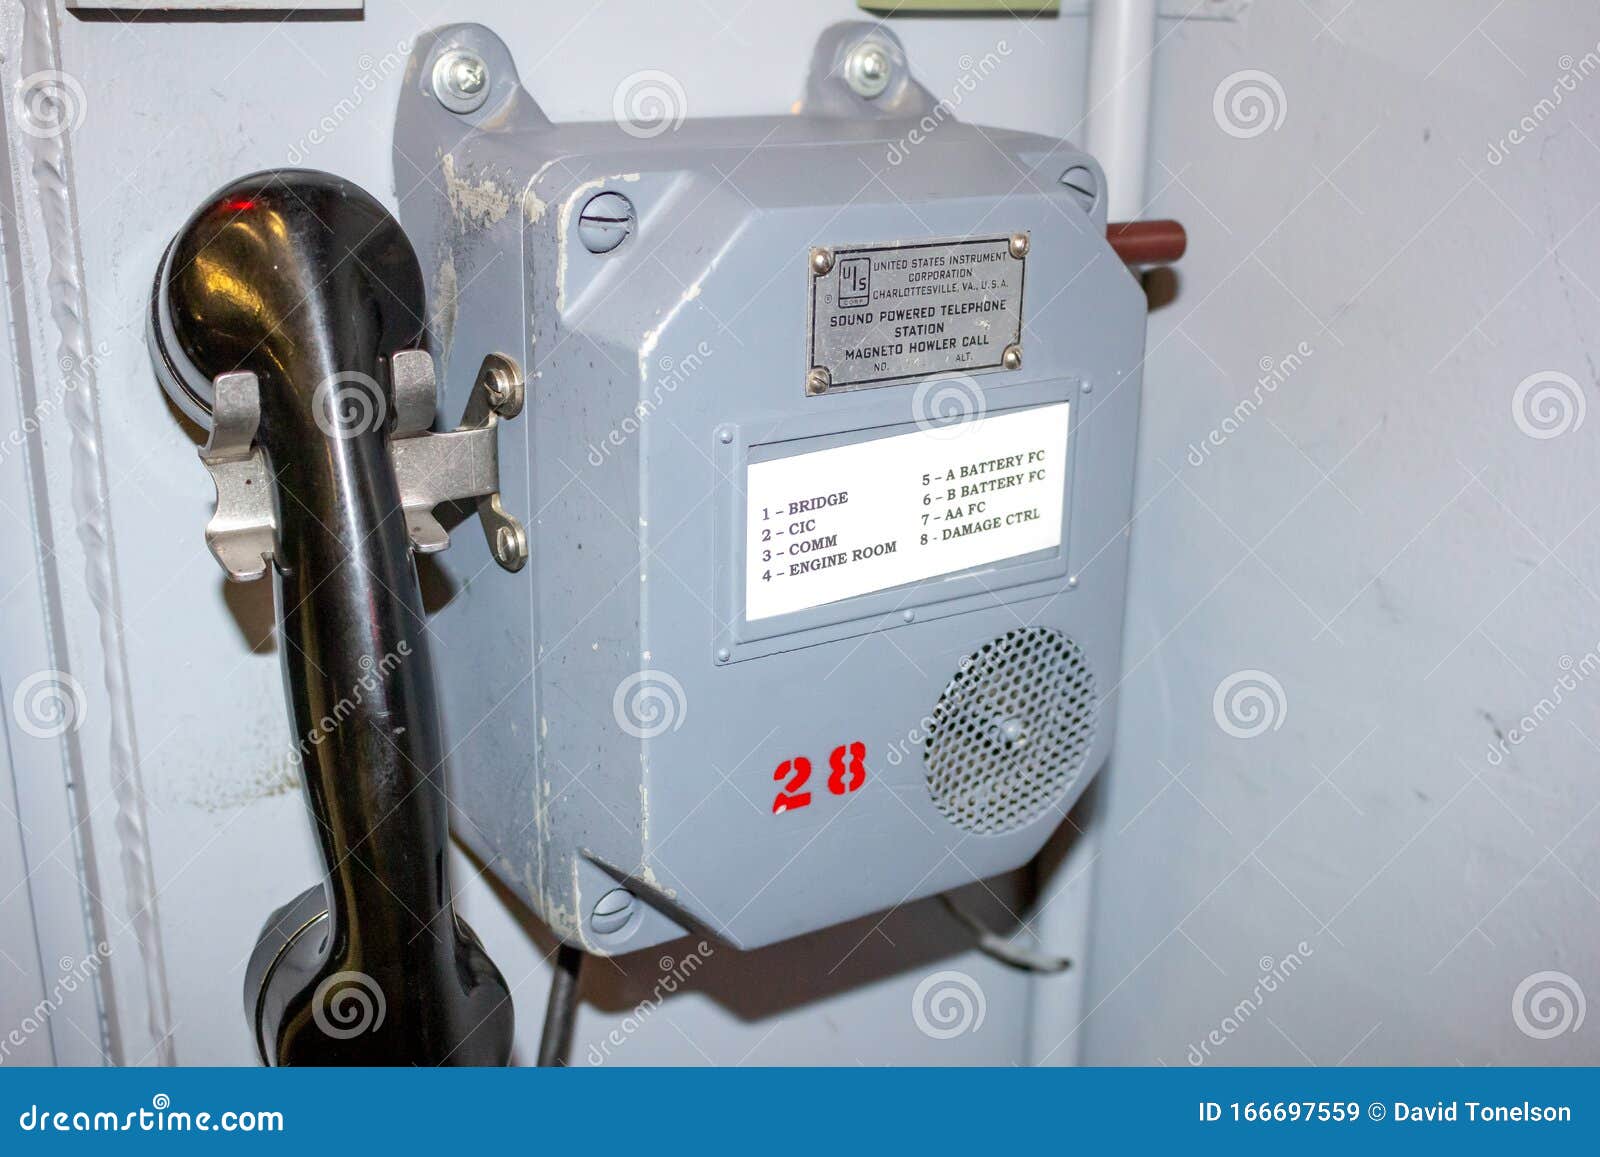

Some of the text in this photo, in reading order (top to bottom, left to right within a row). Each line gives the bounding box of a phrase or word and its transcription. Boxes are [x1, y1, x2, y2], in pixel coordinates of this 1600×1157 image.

[873, 252, 1007, 272] UNITED STATES INSTRUMENT
[908, 268, 973, 282] CORPORATION
[830, 299, 1006, 327] SOUND POWERED TELEPHONE
[895, 322, 945, 337] STATION
[845, 335, 989, 360] MAGNETO HOWLER CALL
[922, 474, 930, 486] 5
[946, 469, 956, 481] A
[960, 454, 1024, 478] BATTERY
[1028, 450, 1045, 463] FC
[923, 494, 932, 506] 6
[947, 489, 956, 501] B
[961, 474, 1024, 498] BATTERY
[1029, 469, 1046, 483] FC
[762, 508, 770, 520] 1
[788, 491, 849, 515] BRIDGE
[921, 514, 930, 526] 7
[945, 507, 963, 521] AA
[968, 501, 986, 515] FC
[762, 529, 771, 542] 2
[789, 519, 816, 535] CIC
[920, 533, 928, 545] 8
[942, 517, 1002, 541] DAMAGE
[1006, 508, 1040, 525] CTRL
[762, 549, 771, 562] 3
[789, 534, 838, 556] COMM
[762, 569, 772, 582] 4
[789, 552, 848, 576] ENGINE
[852, 541, 897, 562] ROOM
[772, 741, 866, 814] 28
